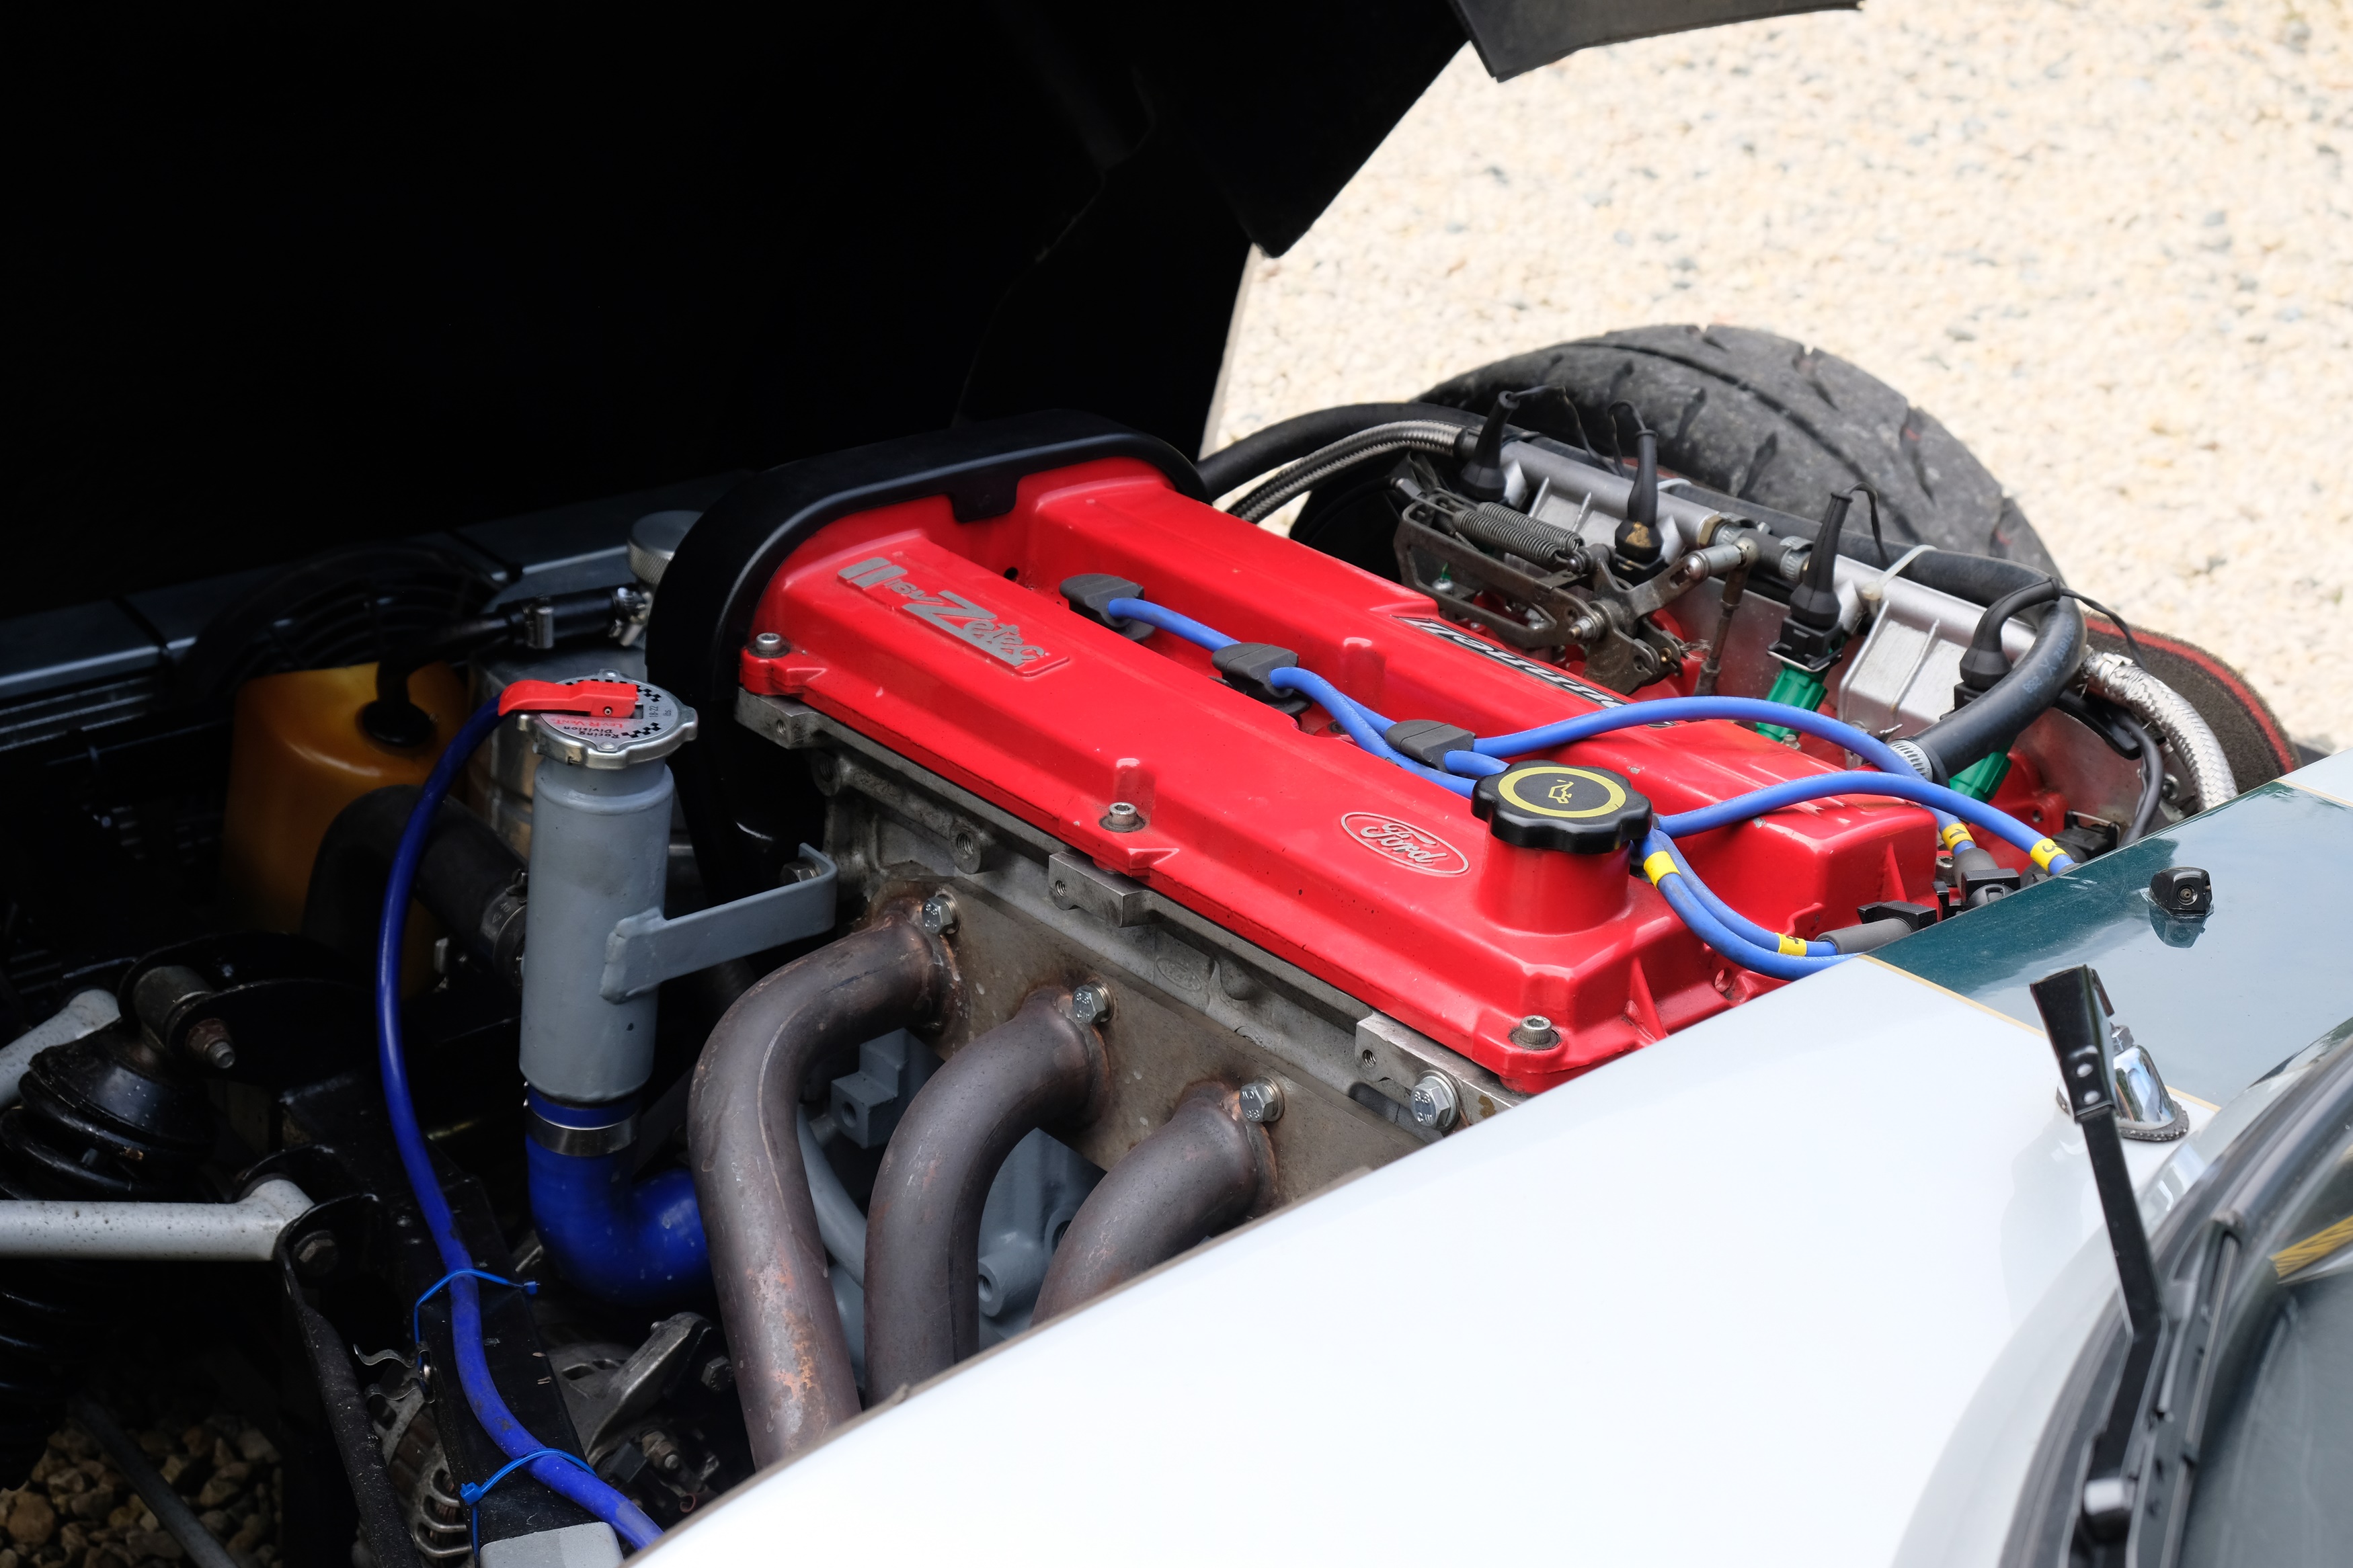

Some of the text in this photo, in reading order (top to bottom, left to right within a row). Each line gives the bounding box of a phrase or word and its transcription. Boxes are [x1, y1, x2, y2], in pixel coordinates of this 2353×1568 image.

[902, 589, 1045, 667] Zetec
[648, 705, 658, 718] 18-22
[563, 725, 613, 734] Division
[578, 730, 620, 739] Racing
[1360, 823, 1448, 864] Ford
